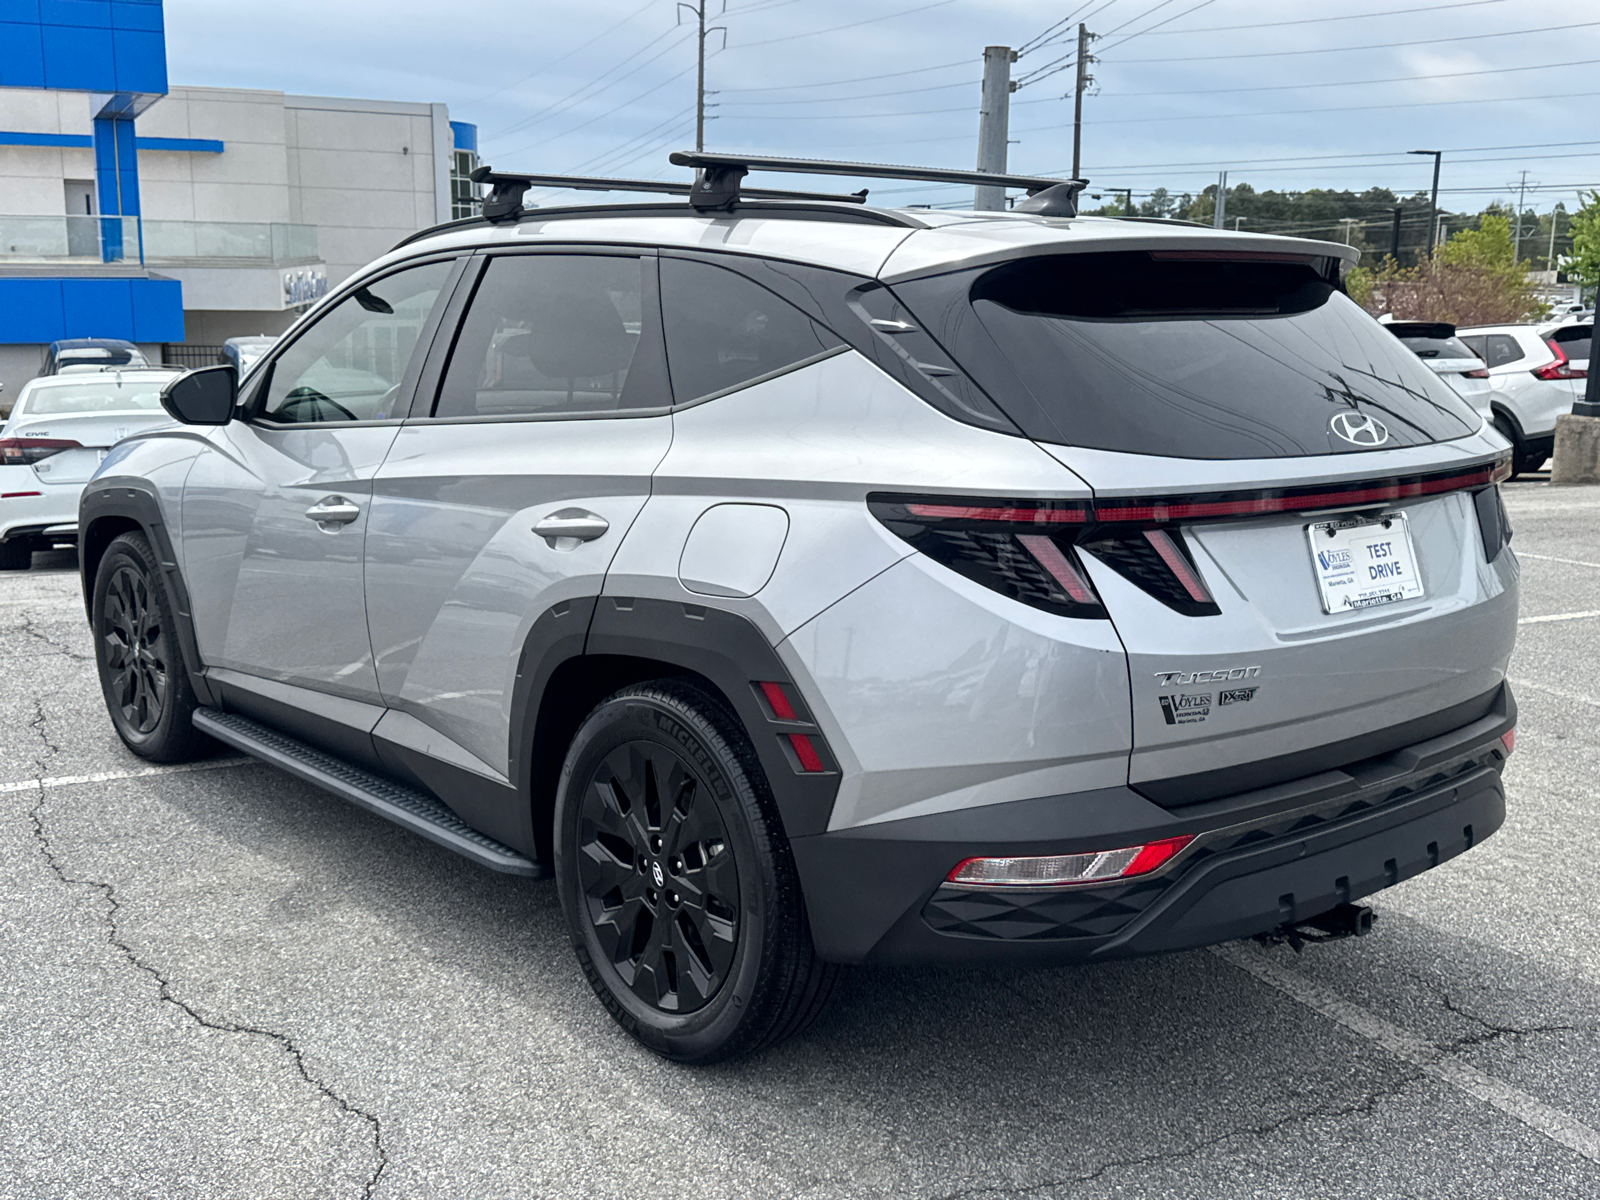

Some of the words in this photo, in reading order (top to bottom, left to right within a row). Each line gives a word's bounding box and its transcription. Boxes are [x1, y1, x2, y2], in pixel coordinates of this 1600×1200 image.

[1320, 550, 1351, 568] VOYLES
[1366, 542, 1393, 559] TEST
[1368, 561, 1402, 580] DRIVE
[1390, 592, 1403, 601] GA
[1170, 694, 1212, 712] VOYLES
[1176, 710, 1202, 718] HONDA
[658, 715, 728, 797] MICHELIN
